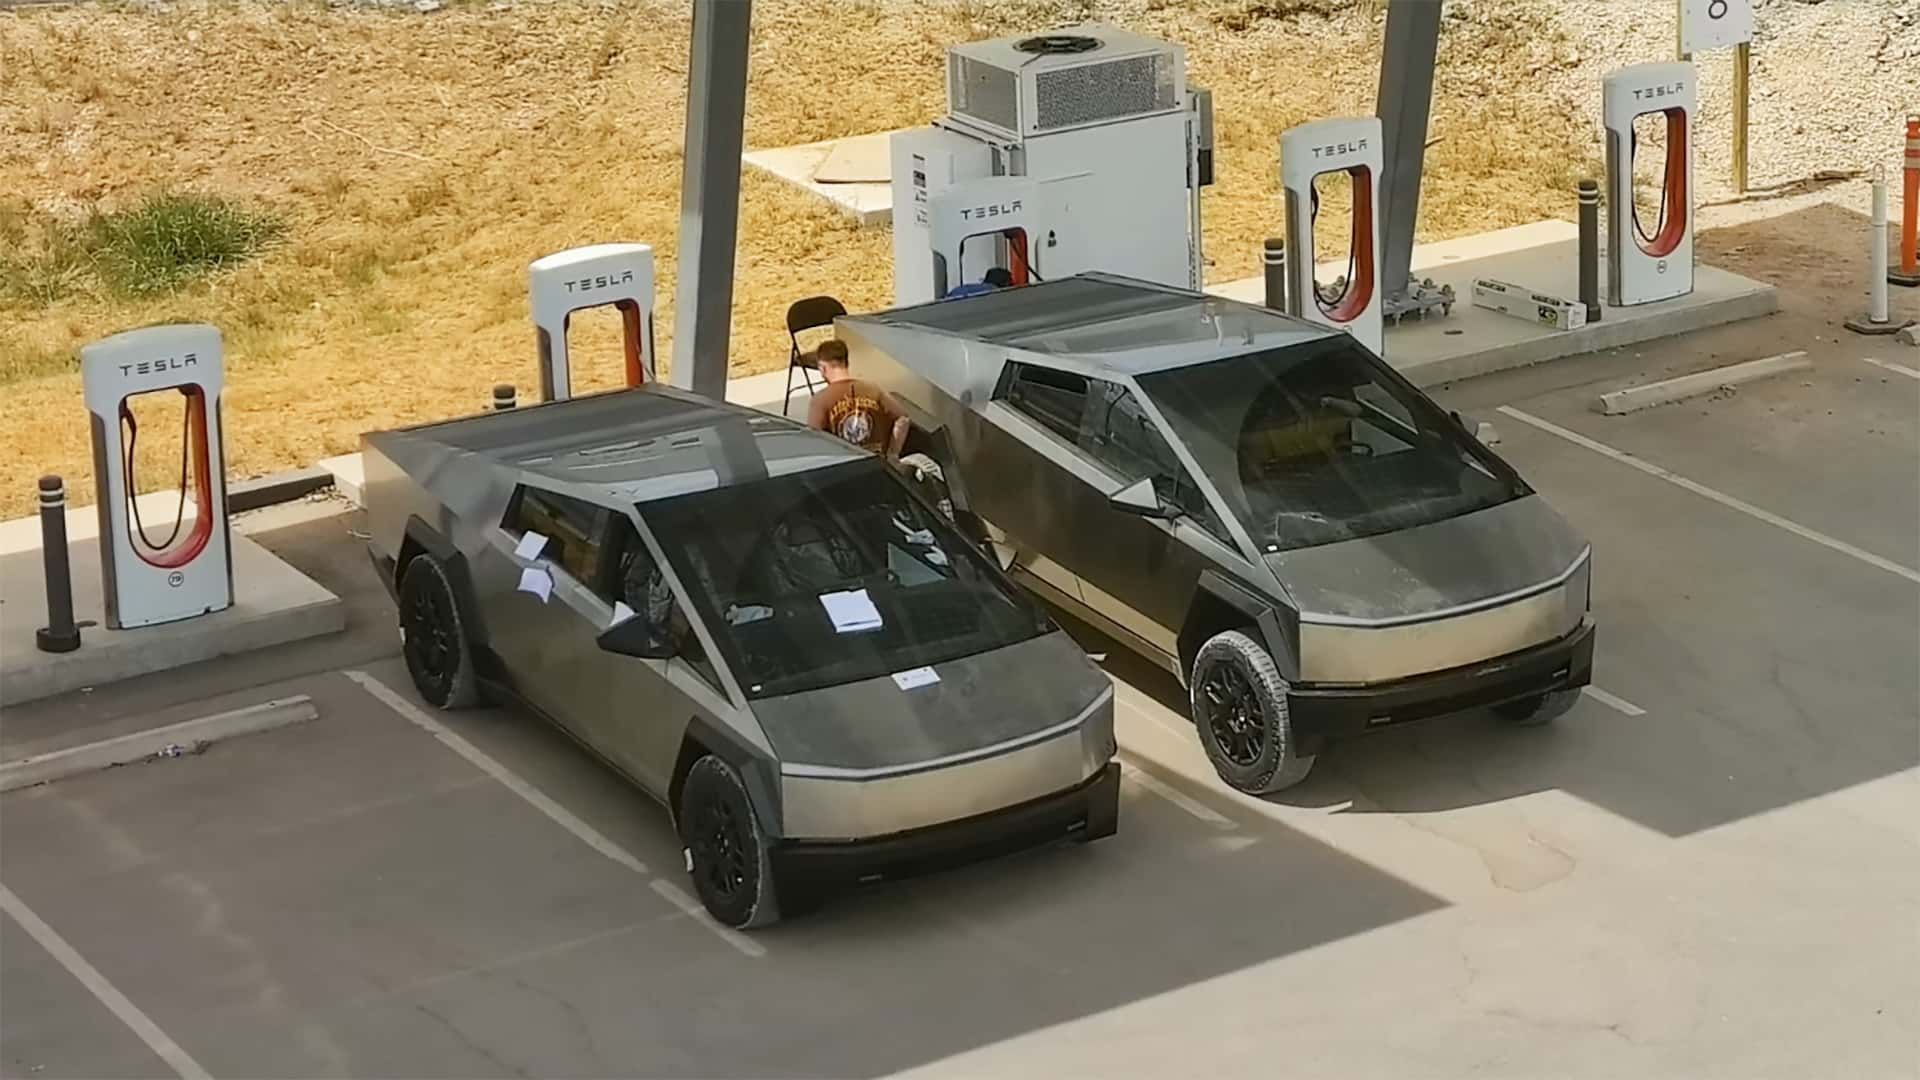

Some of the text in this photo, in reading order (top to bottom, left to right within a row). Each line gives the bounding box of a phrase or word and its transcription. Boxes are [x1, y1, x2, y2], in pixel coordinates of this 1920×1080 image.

[1632, 82, 1684, 100] TESLA
[1311, 139, 1368, 158] TESLA
[960, 200, 1022, 220] TESLA
[563, 270, 633, 293] TESLA
[118, 353, 197, 376] TESLA
